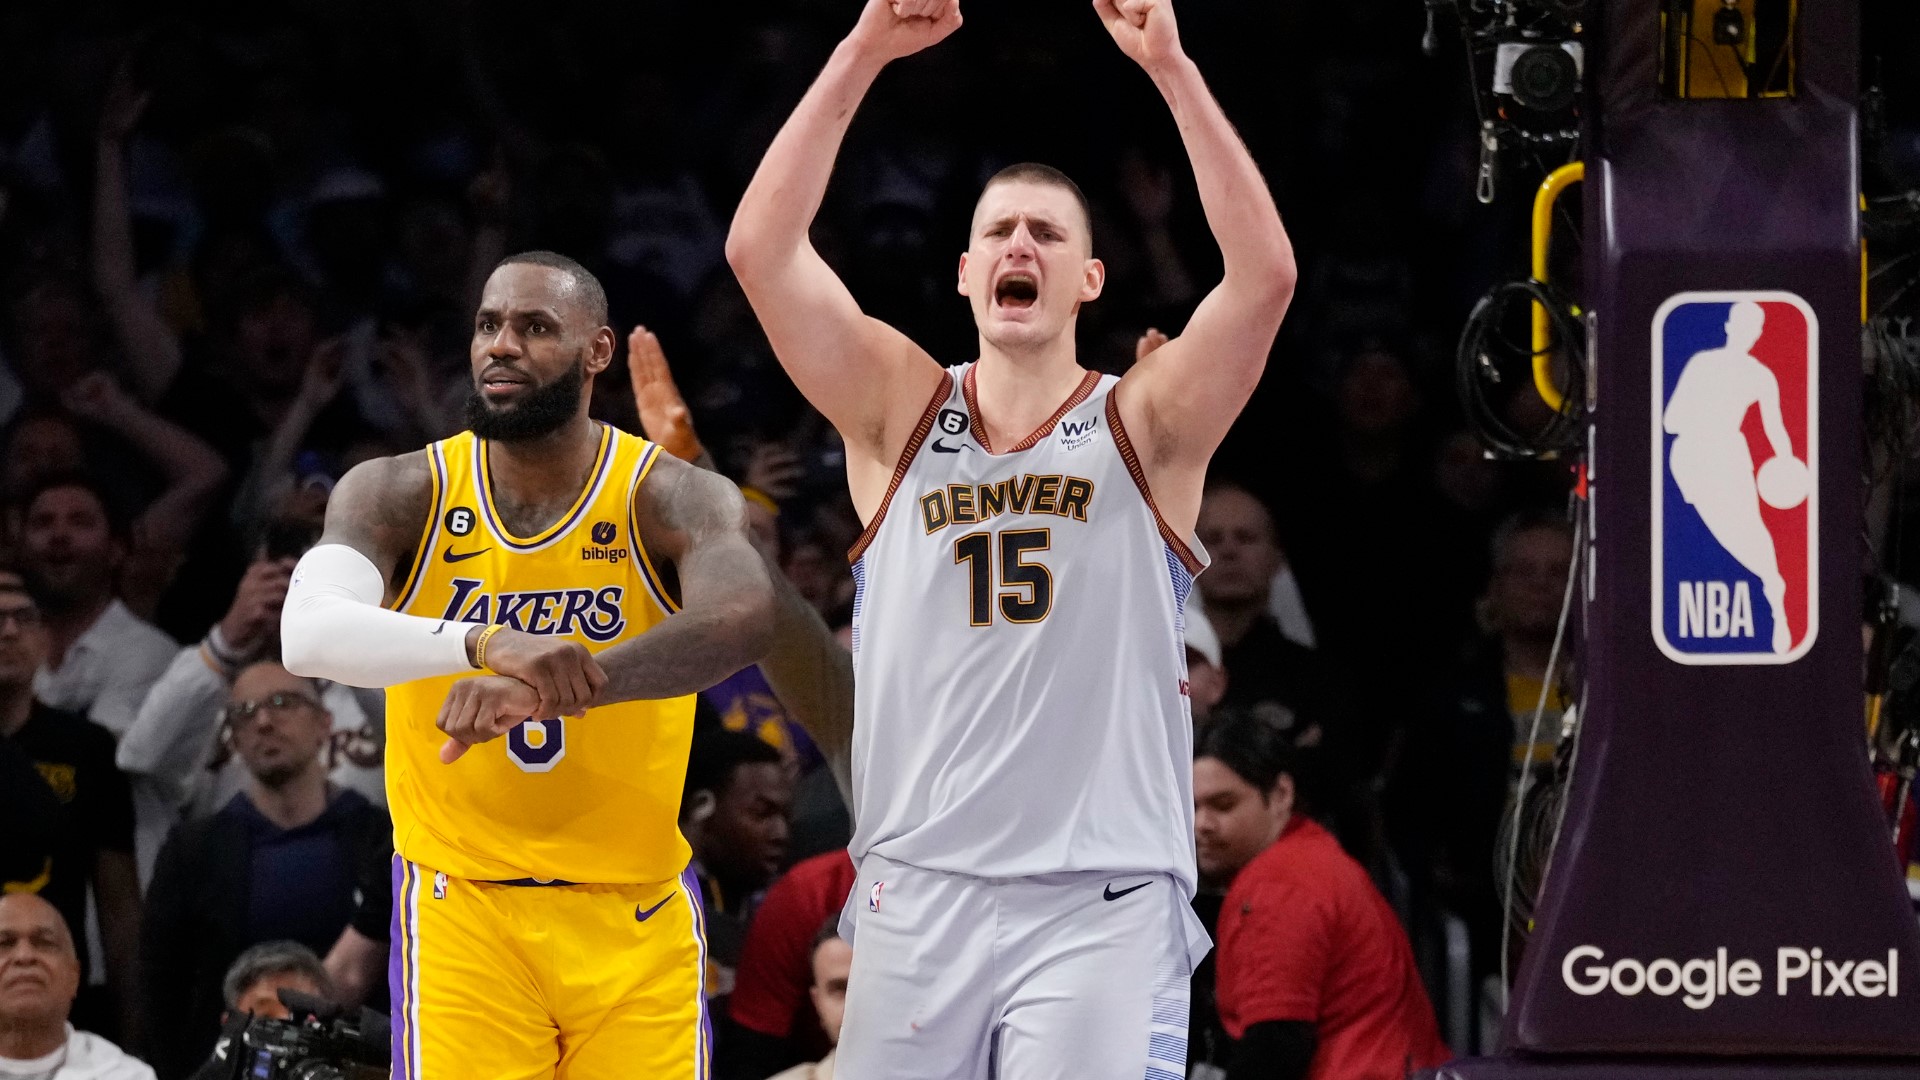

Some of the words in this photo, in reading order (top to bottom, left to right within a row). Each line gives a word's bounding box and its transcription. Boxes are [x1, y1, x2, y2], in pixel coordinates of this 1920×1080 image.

[944, 412, 963, 433] 6
[1061, 430, 1096, 445] Western
[1067, 438, 1091, 451] Union
[451, 511, 469, 533] 6
[919, 474, 1094, 535] DENVER
[582, 547, 627, 563] bibigo
[955, 528, 1053, 627] 15
[442, 577, 627, 643] LAKERS
[1678, 581, 1754, 638] NBA
[1562, 945, 1762, 1009] Google
[1777, 947, 1898, 997] Pixel
